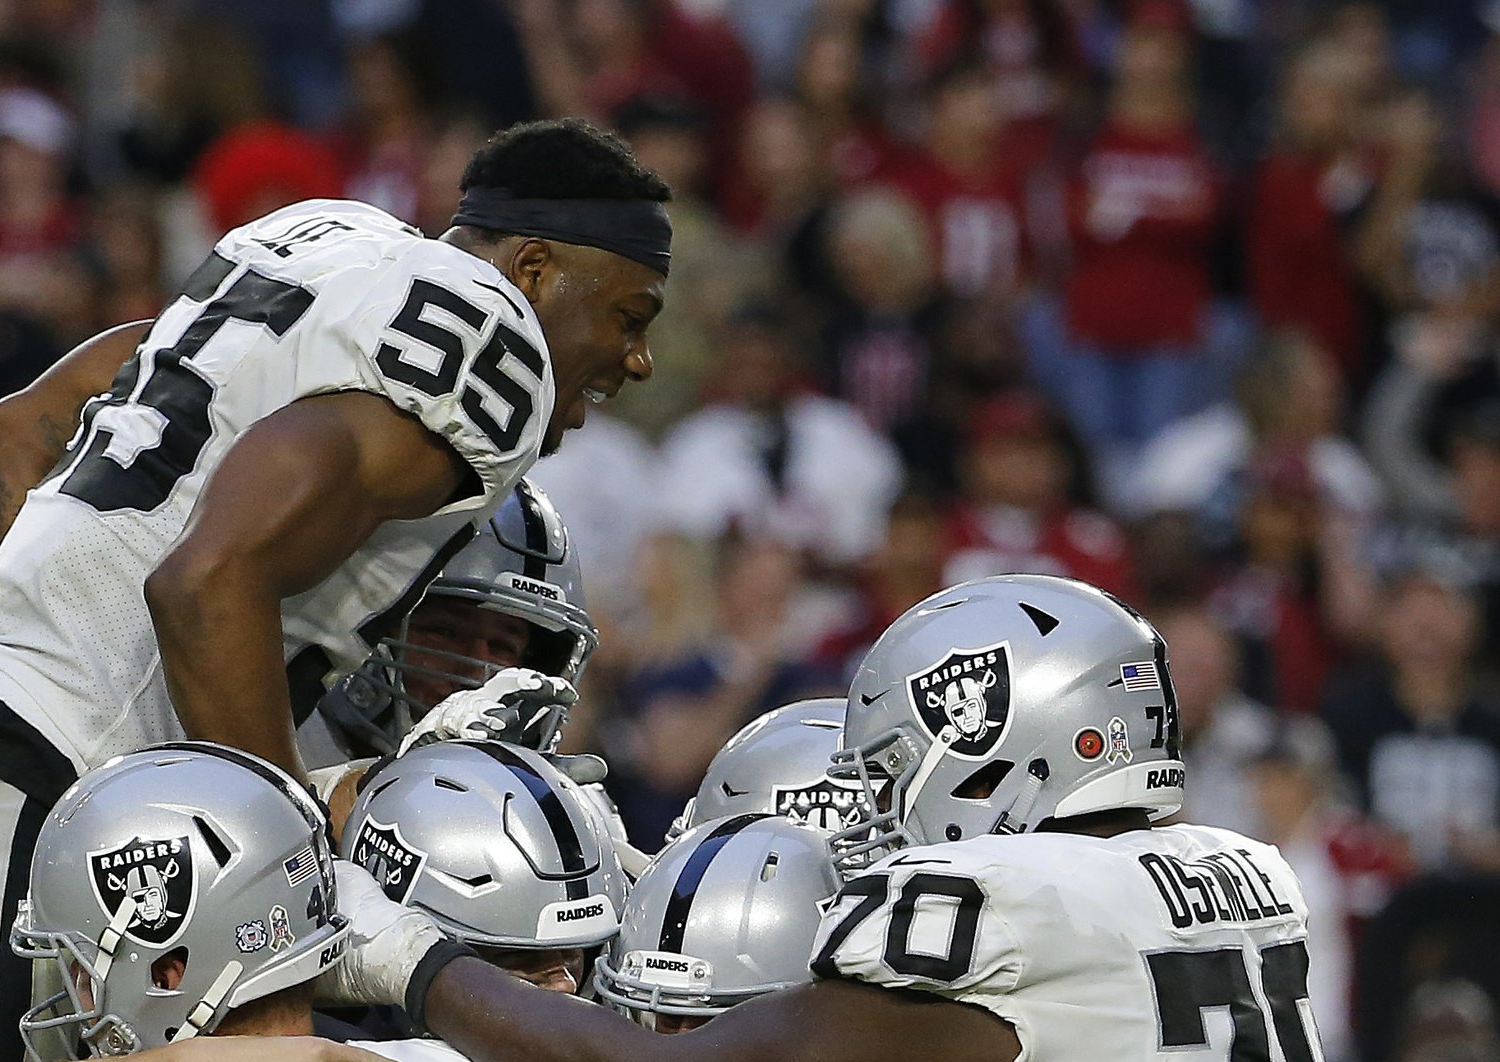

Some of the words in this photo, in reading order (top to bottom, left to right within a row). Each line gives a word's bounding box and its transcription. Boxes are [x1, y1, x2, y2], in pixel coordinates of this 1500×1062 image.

[375, 278, 544, 452] 55
[512, 578, 558, 600] RAIDERS
[919, 652, 997, 690] RAIDERS
[785, 791, 866, 804] RAIDERS
[100, 838, 181, 870] RAIDERS
[364, 827, 414, 867] RAIDERS
[557, 903, 604, 922] RAIDERS
[812, 874, 985, 982] 70
[646, 958, 688, 972] RAIDERS
